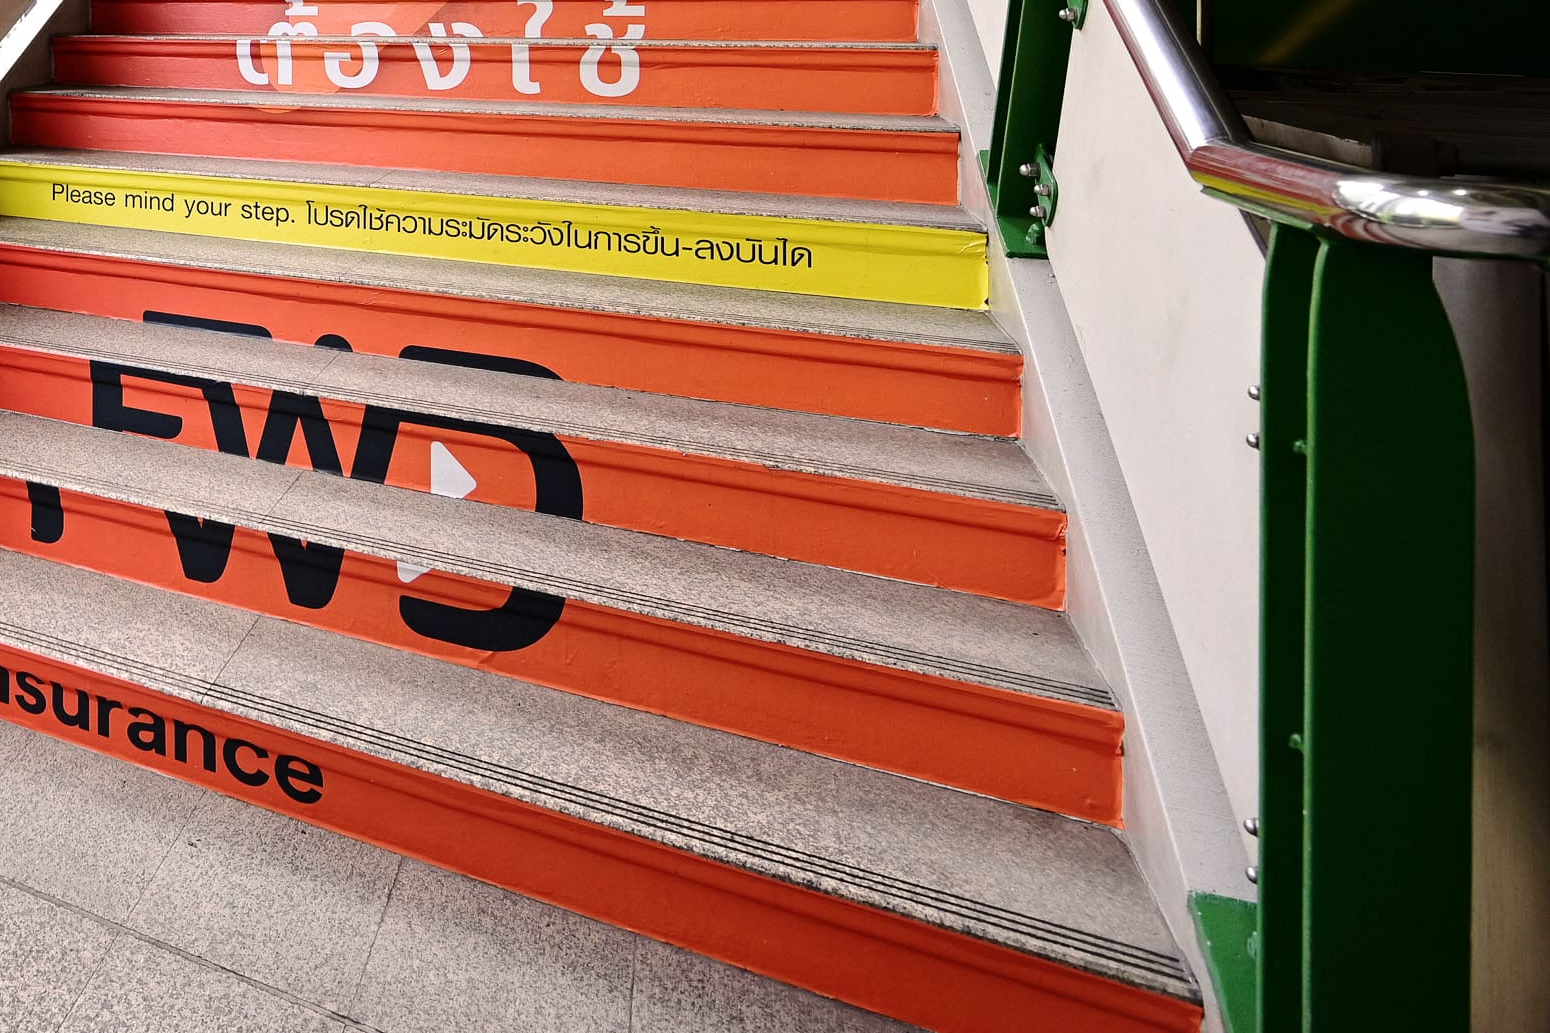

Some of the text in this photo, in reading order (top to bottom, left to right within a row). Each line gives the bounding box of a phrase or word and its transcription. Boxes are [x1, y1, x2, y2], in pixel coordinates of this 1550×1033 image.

[51, 183, 116, 207] Please
[125, 190, 175, 212] mind
[184, 196, 232, 219] your
[241, 201, 296, 228] step.
[27, 309, 585, 652] FWD
